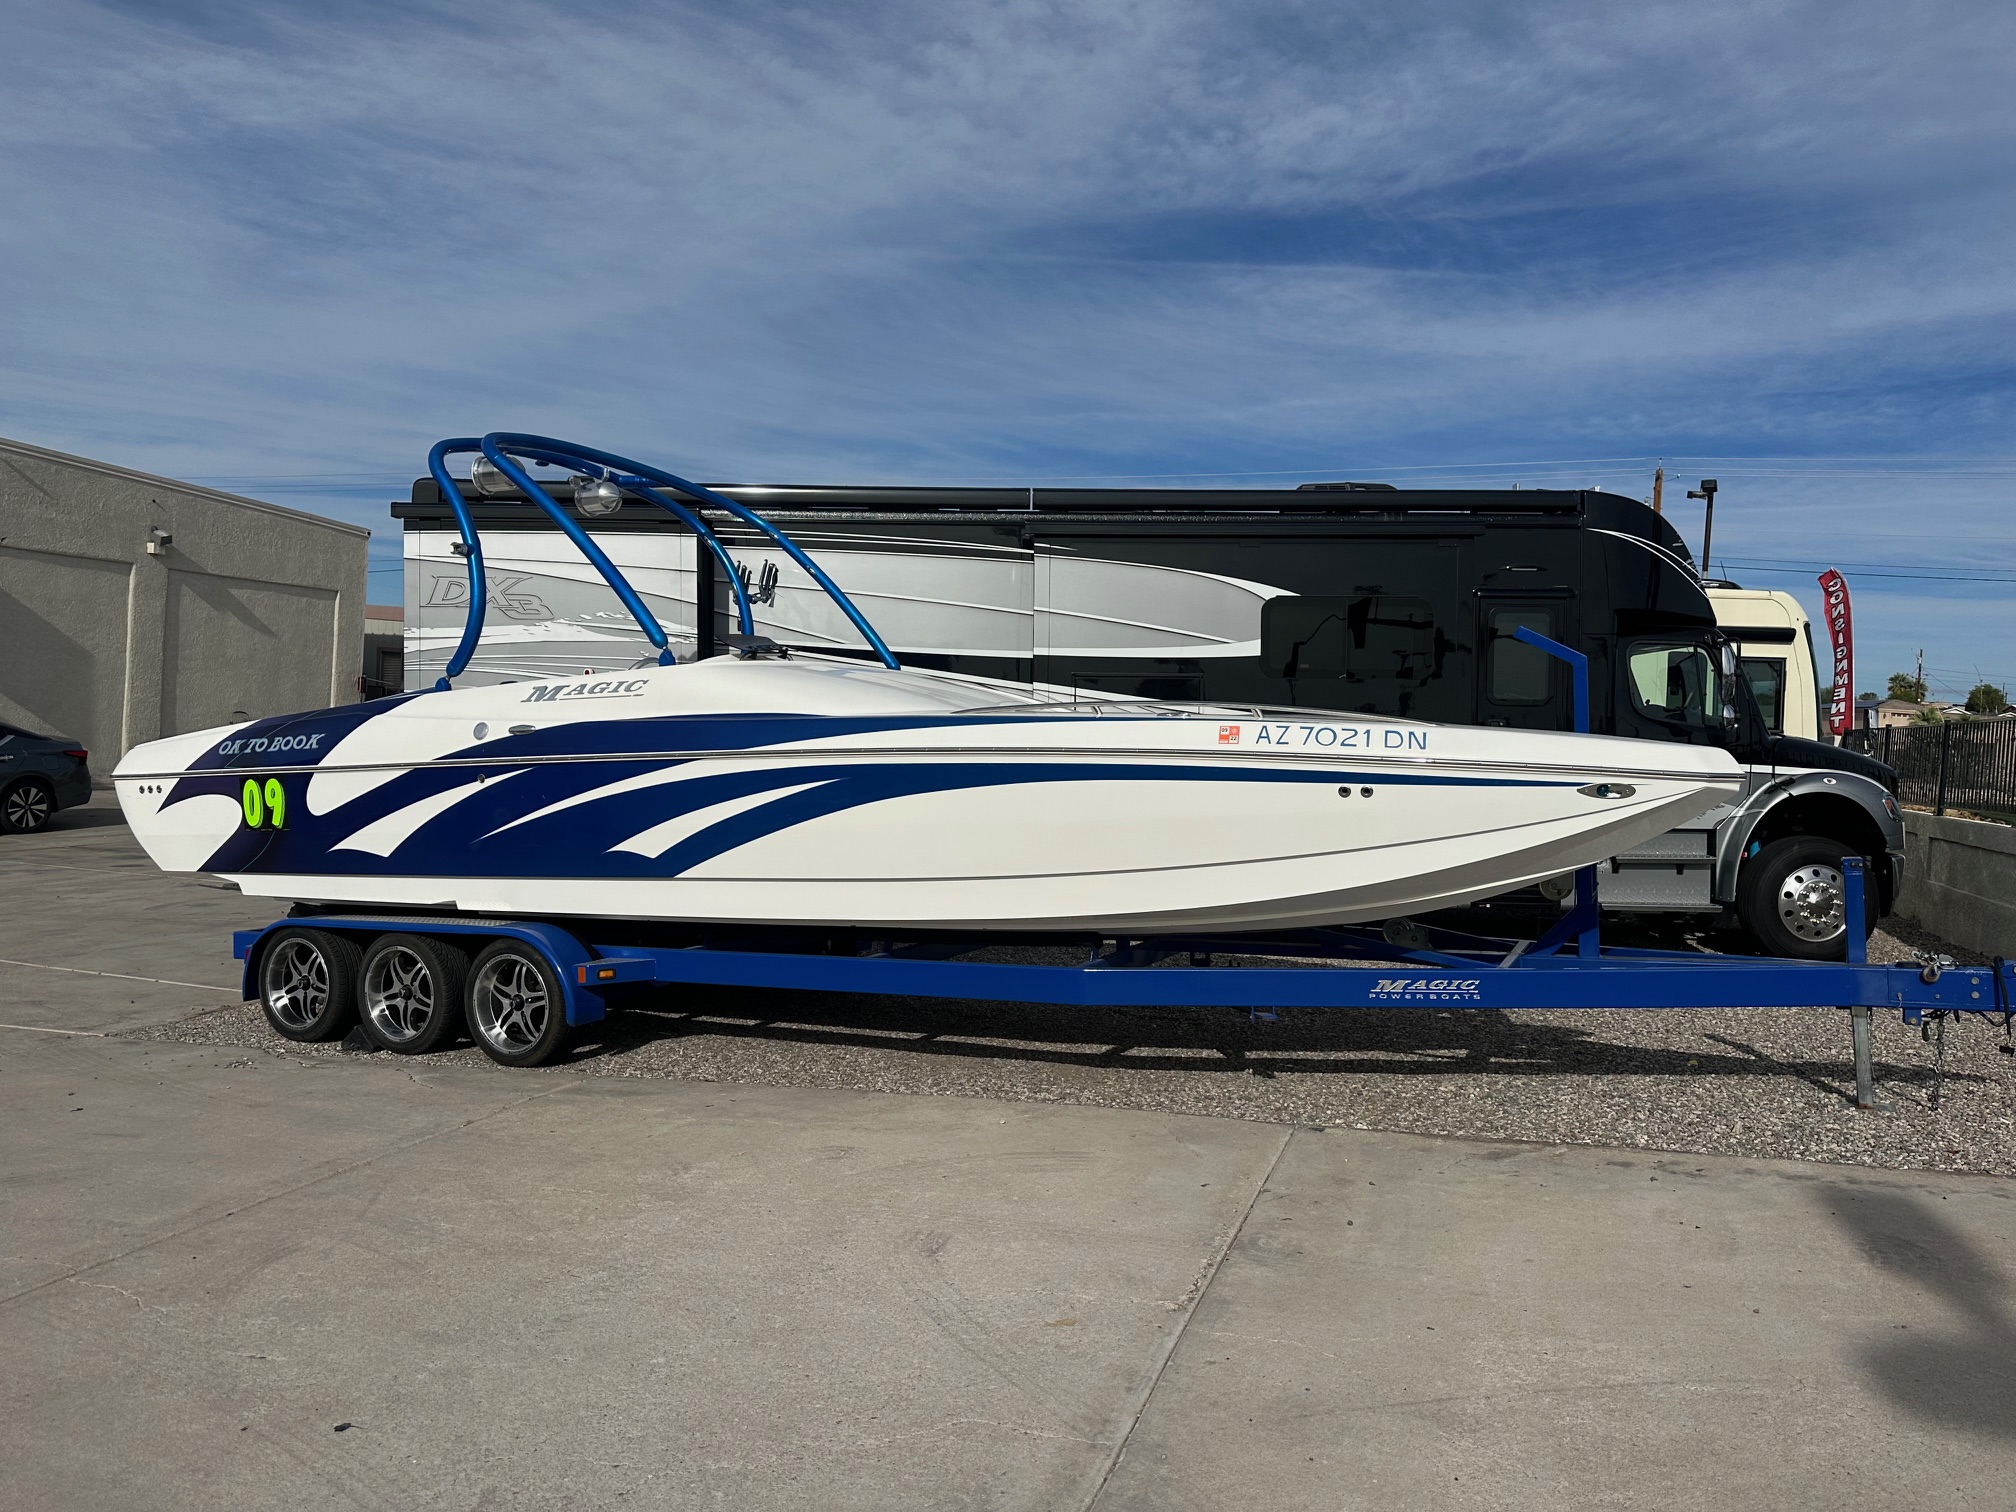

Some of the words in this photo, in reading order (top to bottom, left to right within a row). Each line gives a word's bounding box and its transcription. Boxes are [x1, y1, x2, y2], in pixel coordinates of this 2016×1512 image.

[520, 679, 650, 703] MAGIC
[218, 739, 248, 755] OK
[243, 737, 269, 753] TO
[267, 733, 326, 752] BOOK
[1255, 725, 1290, 745] AZ
[1299, 726, 1370, 748] 7021
[1384, 730, 1428, 750] DN
[243, 778, 286, 829] 09
[1370, 979, 1481, 993] MAGIC
